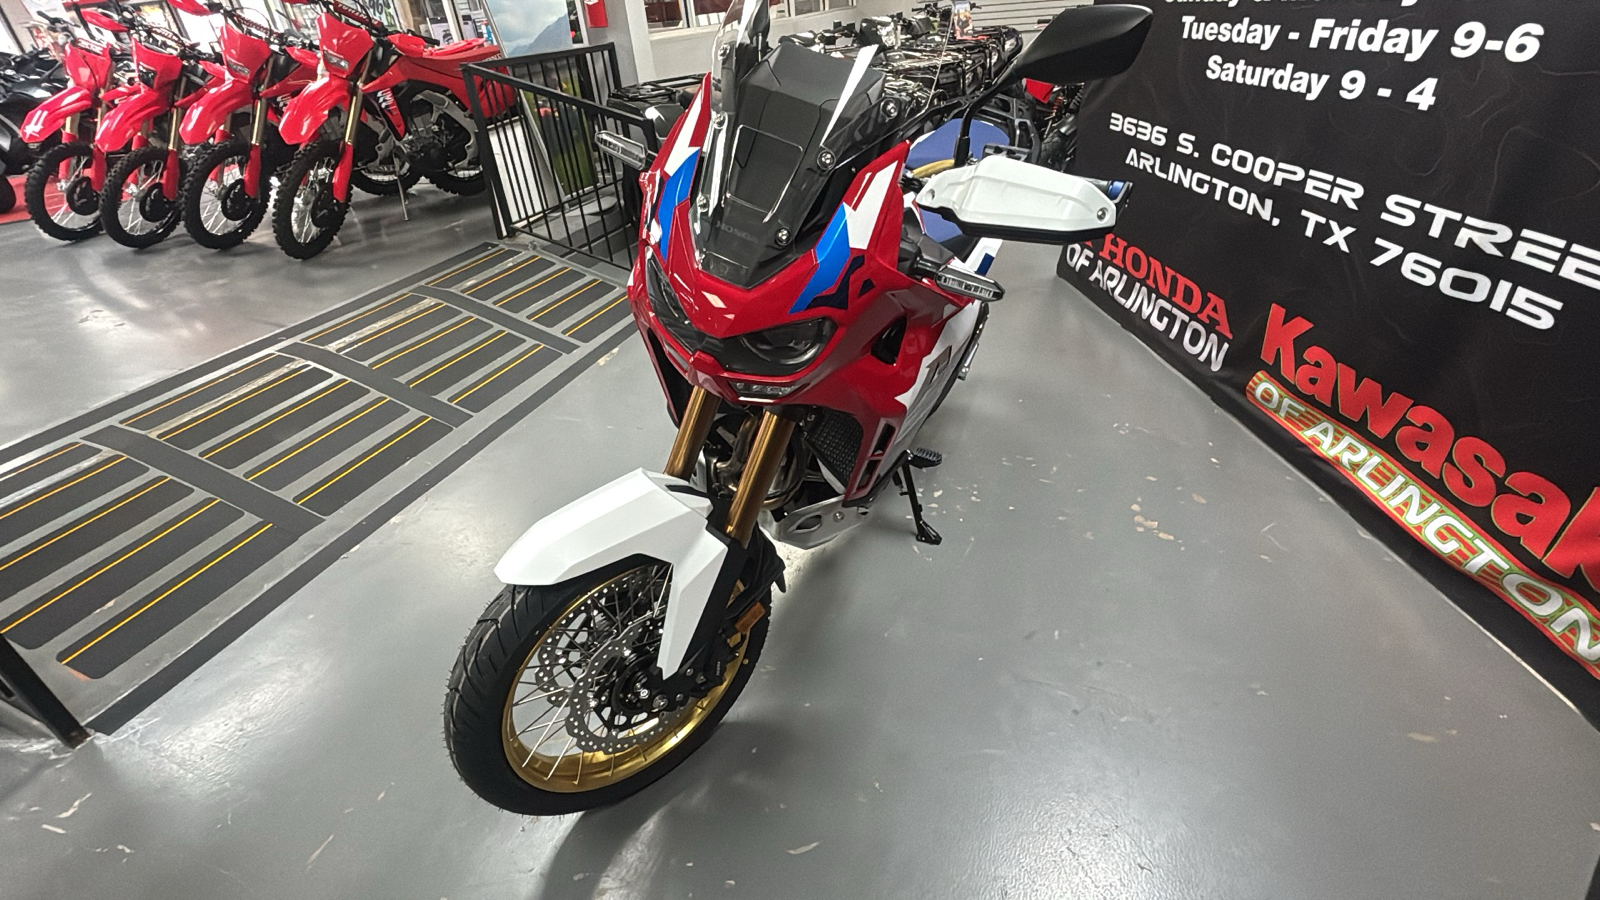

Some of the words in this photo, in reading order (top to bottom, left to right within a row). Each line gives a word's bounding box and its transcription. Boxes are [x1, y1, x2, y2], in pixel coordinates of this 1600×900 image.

[1182, 15, 1281, 50] Tuesday
[1287, 31, 1300, 40] -
[1309, 18, 1439, 62] Friday
[1450, 21, 1545, 63] 9-6
[1205, 54, 1330, 101] Saturday
[1339, 70, 1367, 99] 9
[1377, 87, 1393, 97] -
[1406, 77, 1438, 111] 4
[1109, 112, 1168, 147] 3636
[1176, 132, 1200, 158] S.
[1211, 143, 1365, 211] COOPER
[1099, 233, 1233, 339] HONDA
[1125, 147, 1281, 227] ARLINGTON,
[1300, 209, 1357, 253] TX
[1370, 237, 1564, 330] 76015
[1066, 243, 1094, 272] OF
[1089, 259, 1230, 372] ARLINGTON
[1254, 381, 1306, 419] OF
[1302, 421, 1600, 661] ARLINGTON
